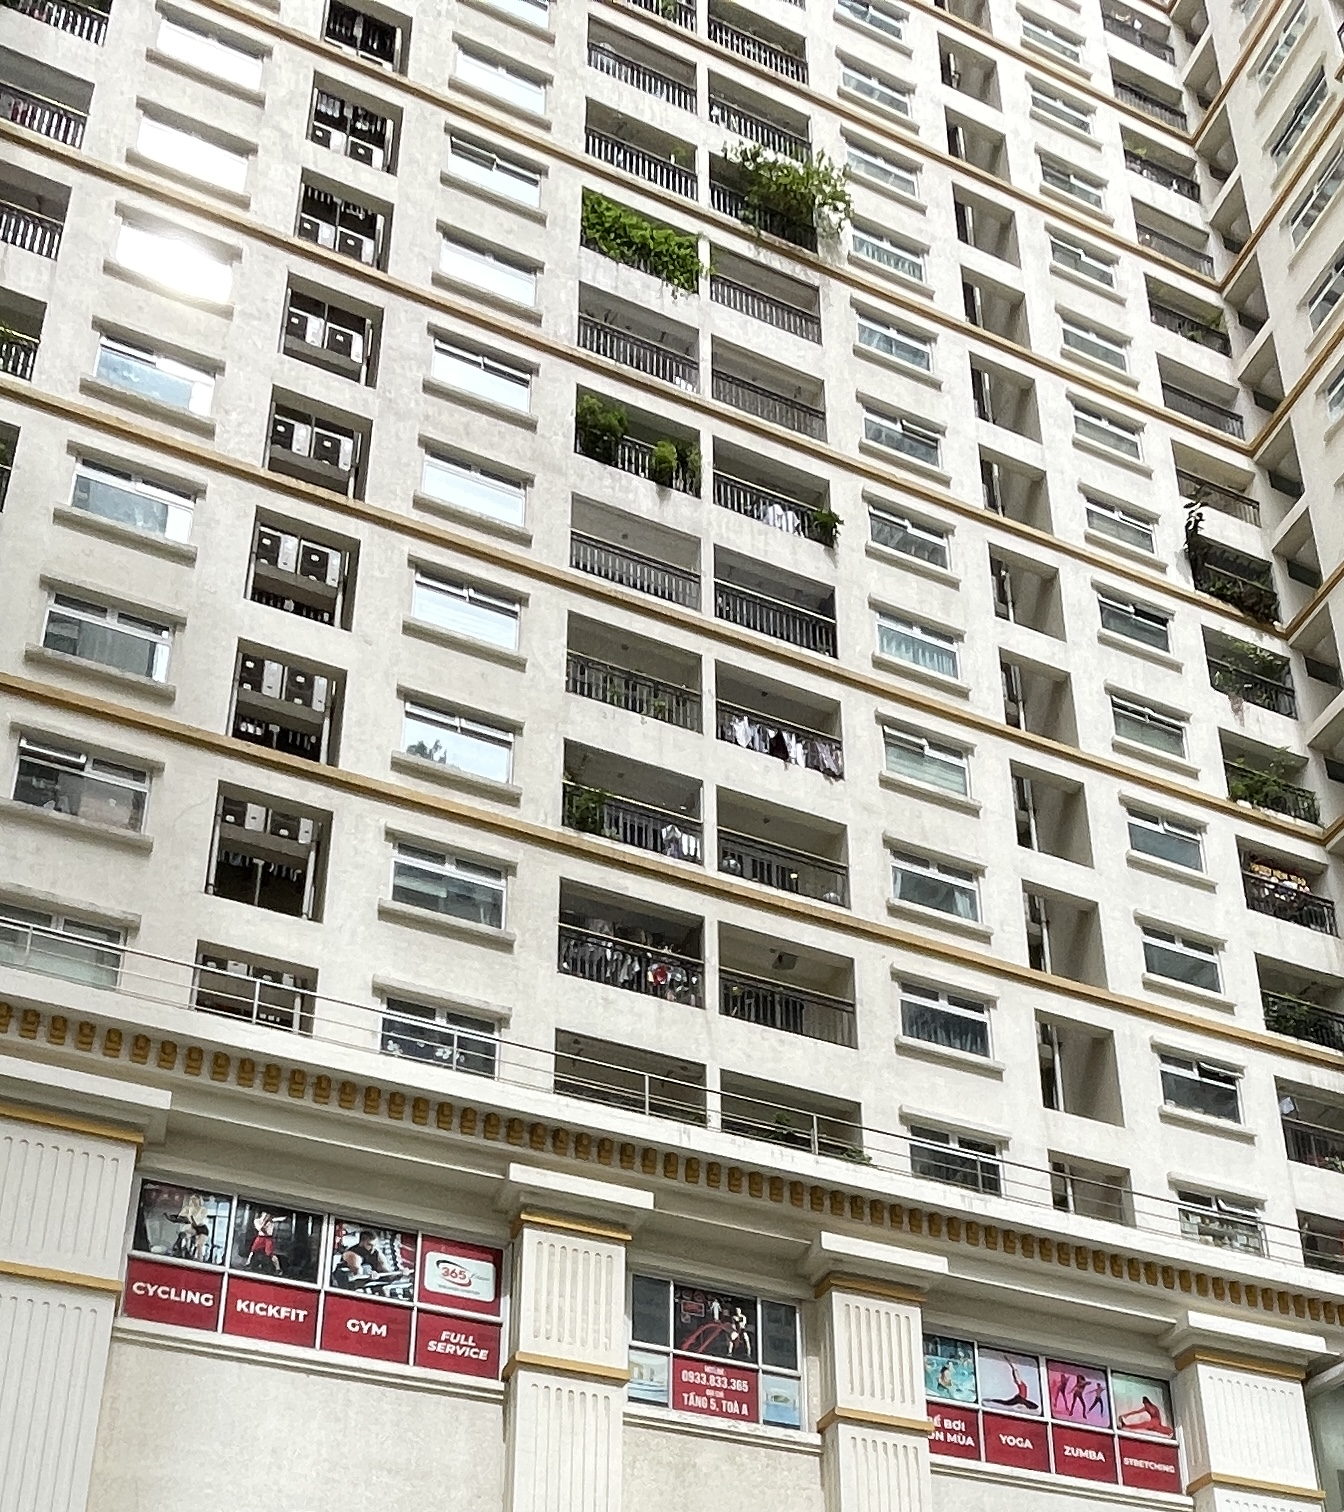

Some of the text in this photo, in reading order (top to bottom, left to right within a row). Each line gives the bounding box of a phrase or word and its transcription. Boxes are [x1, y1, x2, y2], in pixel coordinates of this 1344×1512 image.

[441, 1266, 467, 1280] 365
[132, 1281, 214, 1307] CYCLING
[236, 1299, 308, 1323] KICKFIT
[346, 1318, 388, 1338] GYM
[440, 1330, 476, 1347] FULL
[427, 1340, 489, 1361] SERVICE
[741, 1403, 749, 1416] A
[998, 1433, 1033, 1450] YOGA
[1063, 1445, 1106, 1463] ZUMBA
[1123, 1457, 1175, 1474] STRETCHING
